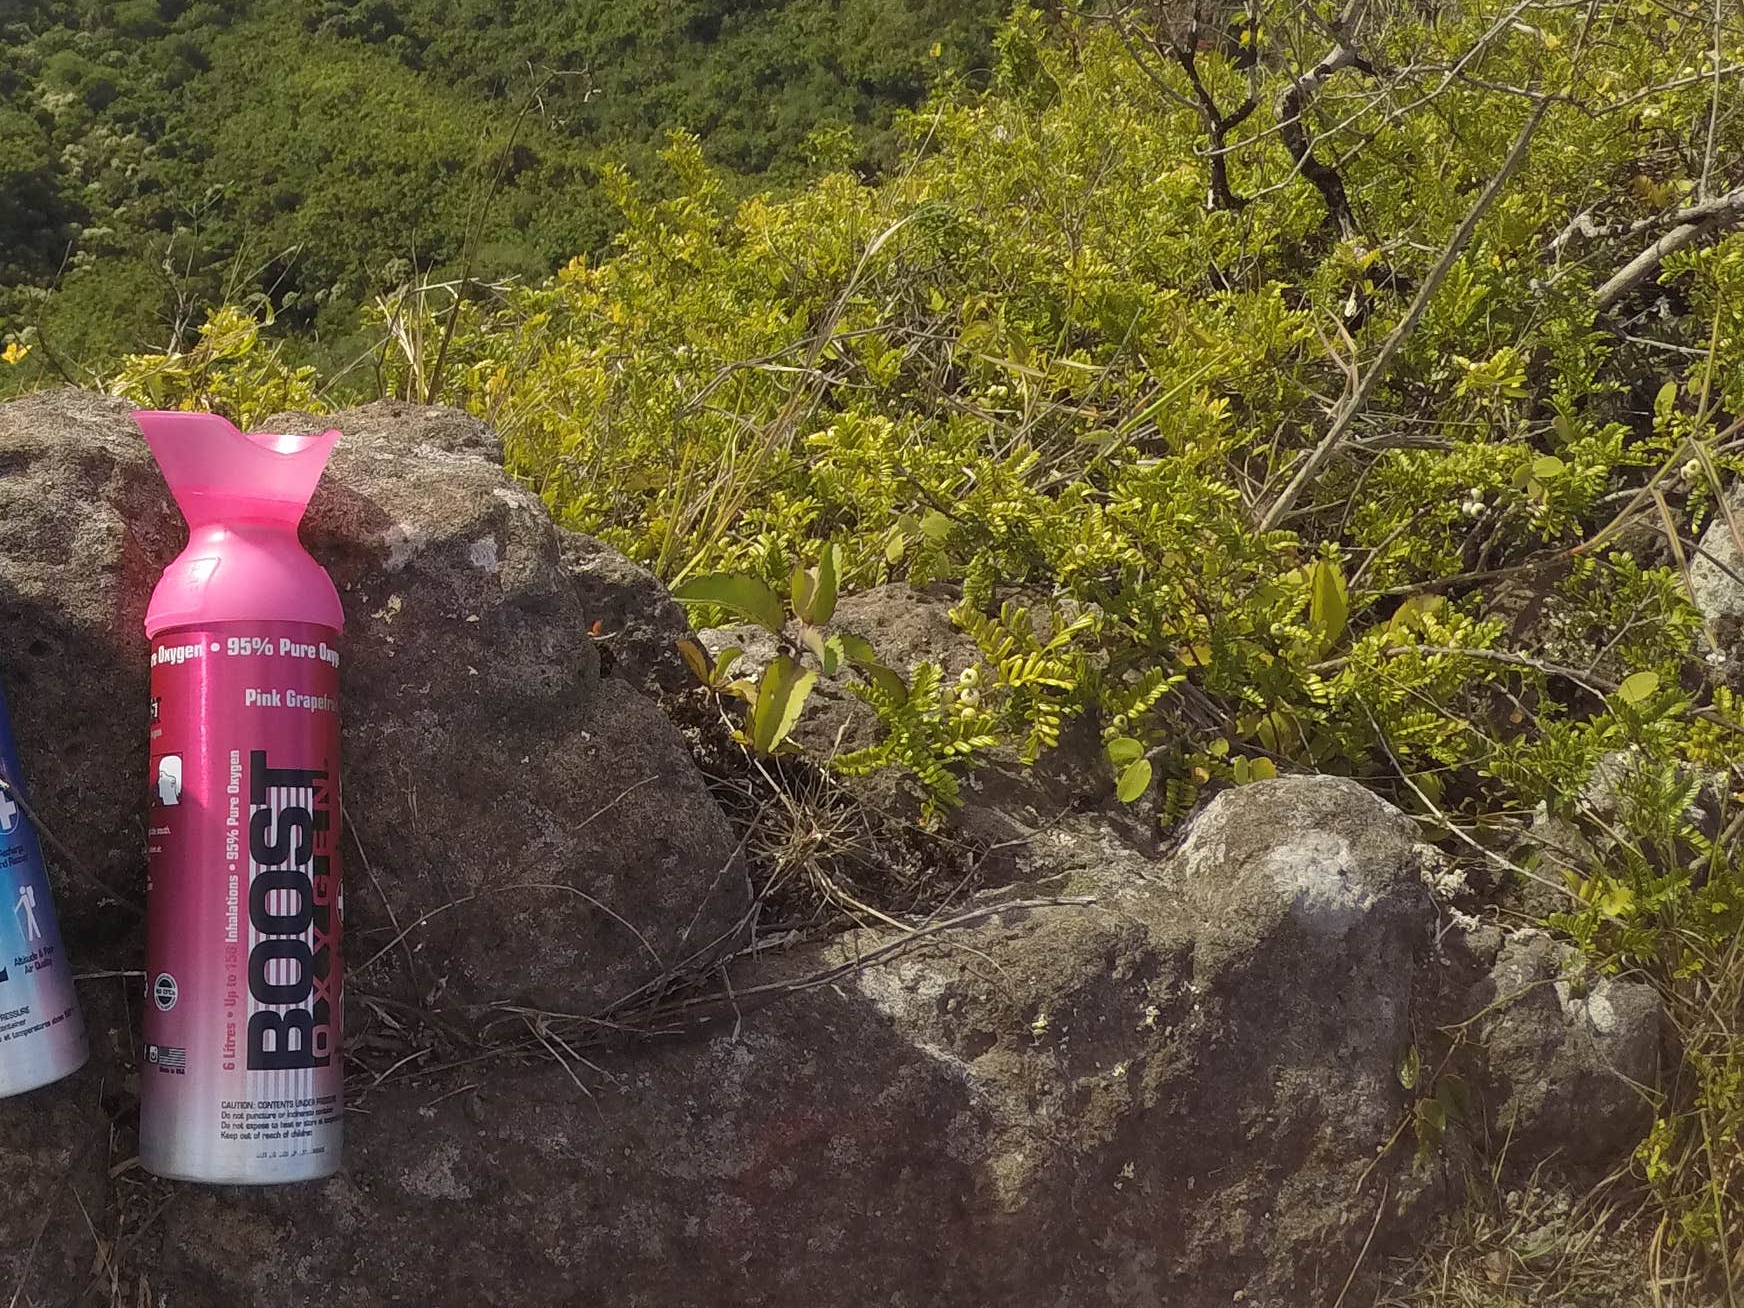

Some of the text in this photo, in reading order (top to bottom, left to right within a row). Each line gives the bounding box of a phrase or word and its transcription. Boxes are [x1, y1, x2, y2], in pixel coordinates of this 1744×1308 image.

[157, 643, 204, 665] Oxygen
[226, 636, 274, 657] 95%
[279, 637, 317, 659] Pure
[245, 687, 281, 708] Pink
[226, 750, 243, 794] Oxygen
[226, 796, 240, 826] Pure
[226, 829, 240, 861] 95%
[225, 874, 239, 943] Inhalations
[246, 749, 316, 1071] BOOST
[225, 973, 237, 987] to
[223, 986, 239, 1007] Up
[222, 1022, 236, 1058] Litres
[222, 1061, 235, 1071] 6
[221, 1100, 254, 1110] CAUTION:
[257, 1100, 294, 1109] CONTENTS
[295, 1098, 316, 1108] UNDER
[221, 1121, 231, 1130] Do
[232, 1121, 245, 1130] not
[246, 1111, 276, 1121] puncture
[220, 1132, 238, 1140] Keep
[253, 1131, 261, 1139] of
[262, 1131, 281, 1139] reach
